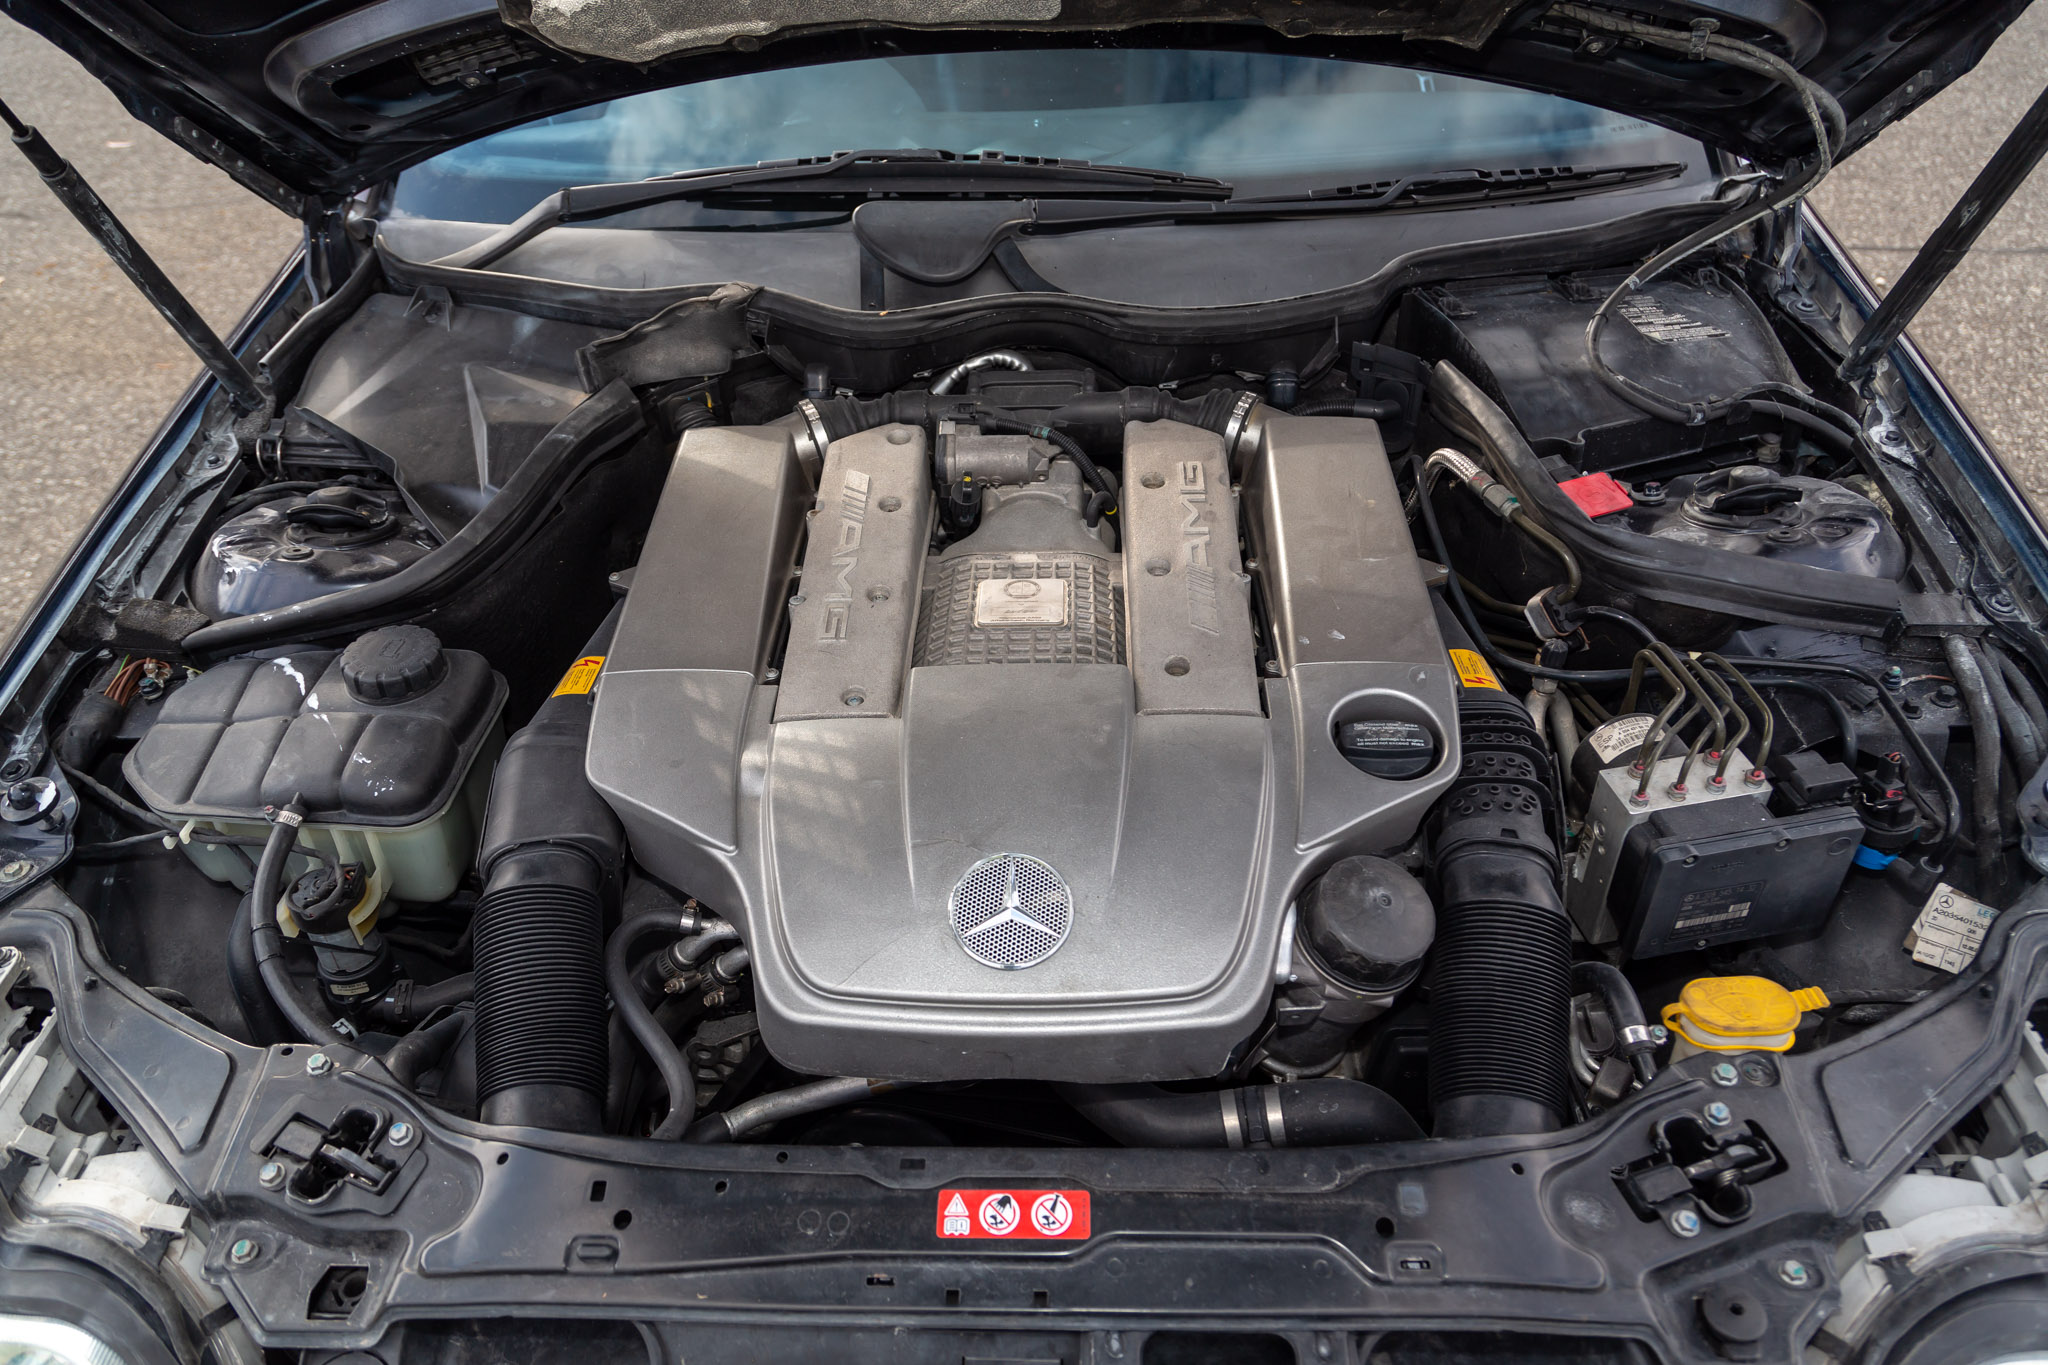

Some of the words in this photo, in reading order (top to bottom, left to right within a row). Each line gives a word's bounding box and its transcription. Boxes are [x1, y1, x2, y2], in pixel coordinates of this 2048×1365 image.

[1176, 460, 1212, 570] AMG
[818, 521, 863, 641] AMG
[1597, 734, 1614, 748] ESP
